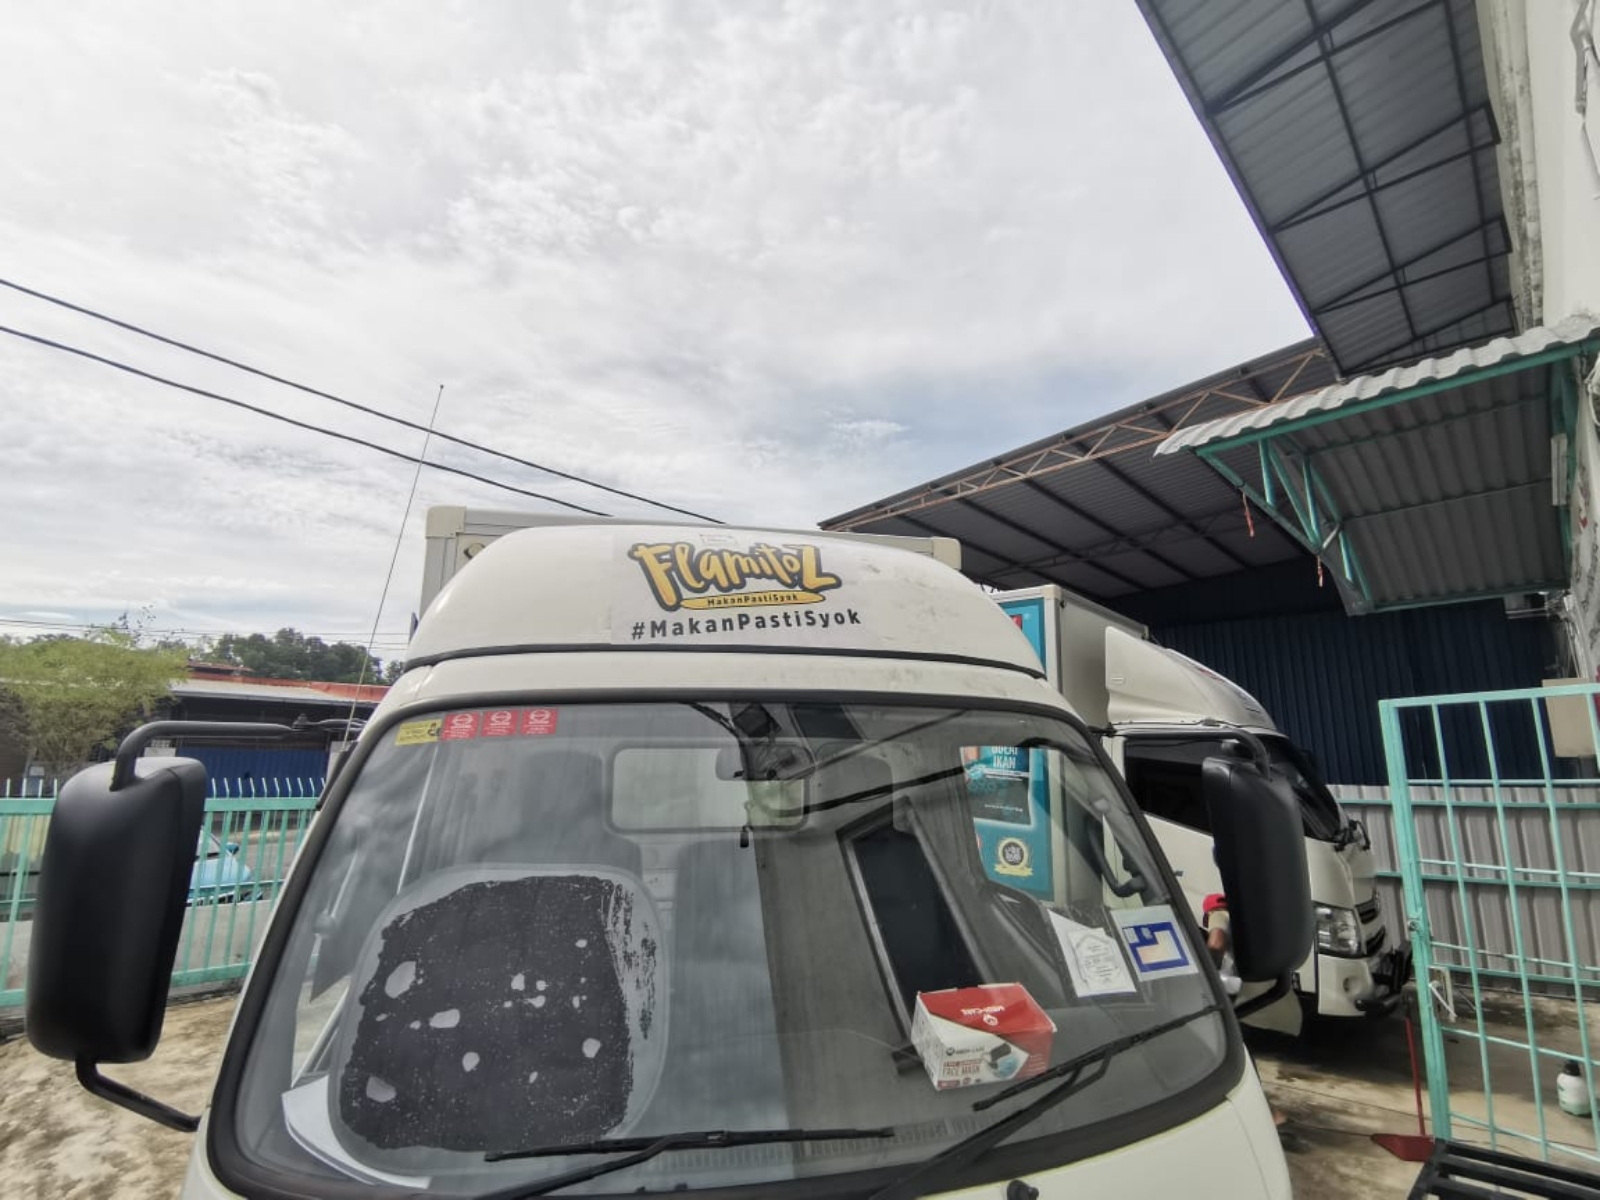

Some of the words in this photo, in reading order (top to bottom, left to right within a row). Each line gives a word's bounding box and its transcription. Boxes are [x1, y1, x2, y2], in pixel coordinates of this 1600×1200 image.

[707, 593, 798, 606] MakanPastiSyok
[631, 609, 861, 640] #MakanPastiSyok
[992, 756, 1016, 769] IKAN
